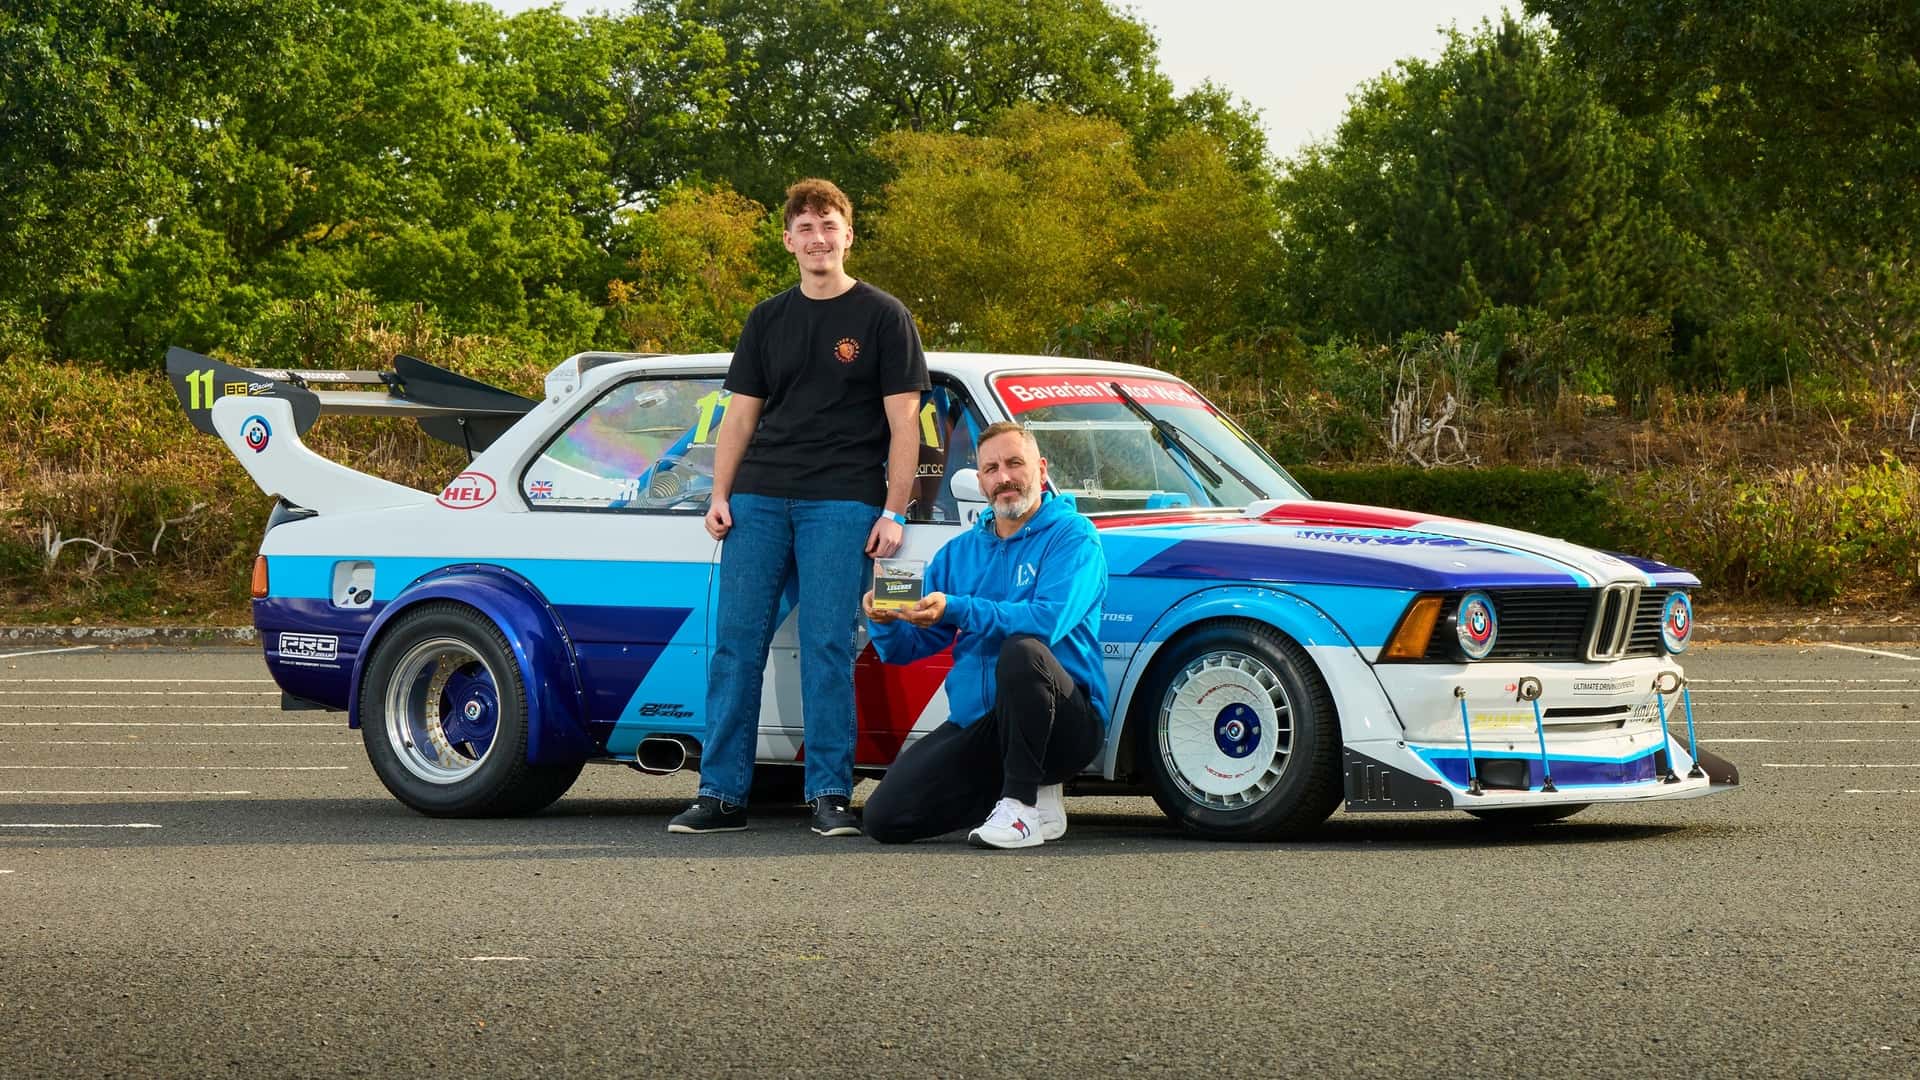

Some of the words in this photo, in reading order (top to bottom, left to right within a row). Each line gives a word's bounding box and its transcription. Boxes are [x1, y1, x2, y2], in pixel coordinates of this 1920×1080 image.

[185, 369, 215, 410] 11
[248, 381, 275, 393] Racing
[1008, 382, 1104, 402] Bavarian
[1095, 382, 1153, 399] Mtor
[443, 487, 485, 501] HEL
[281, 636, 336, 651] PRO
